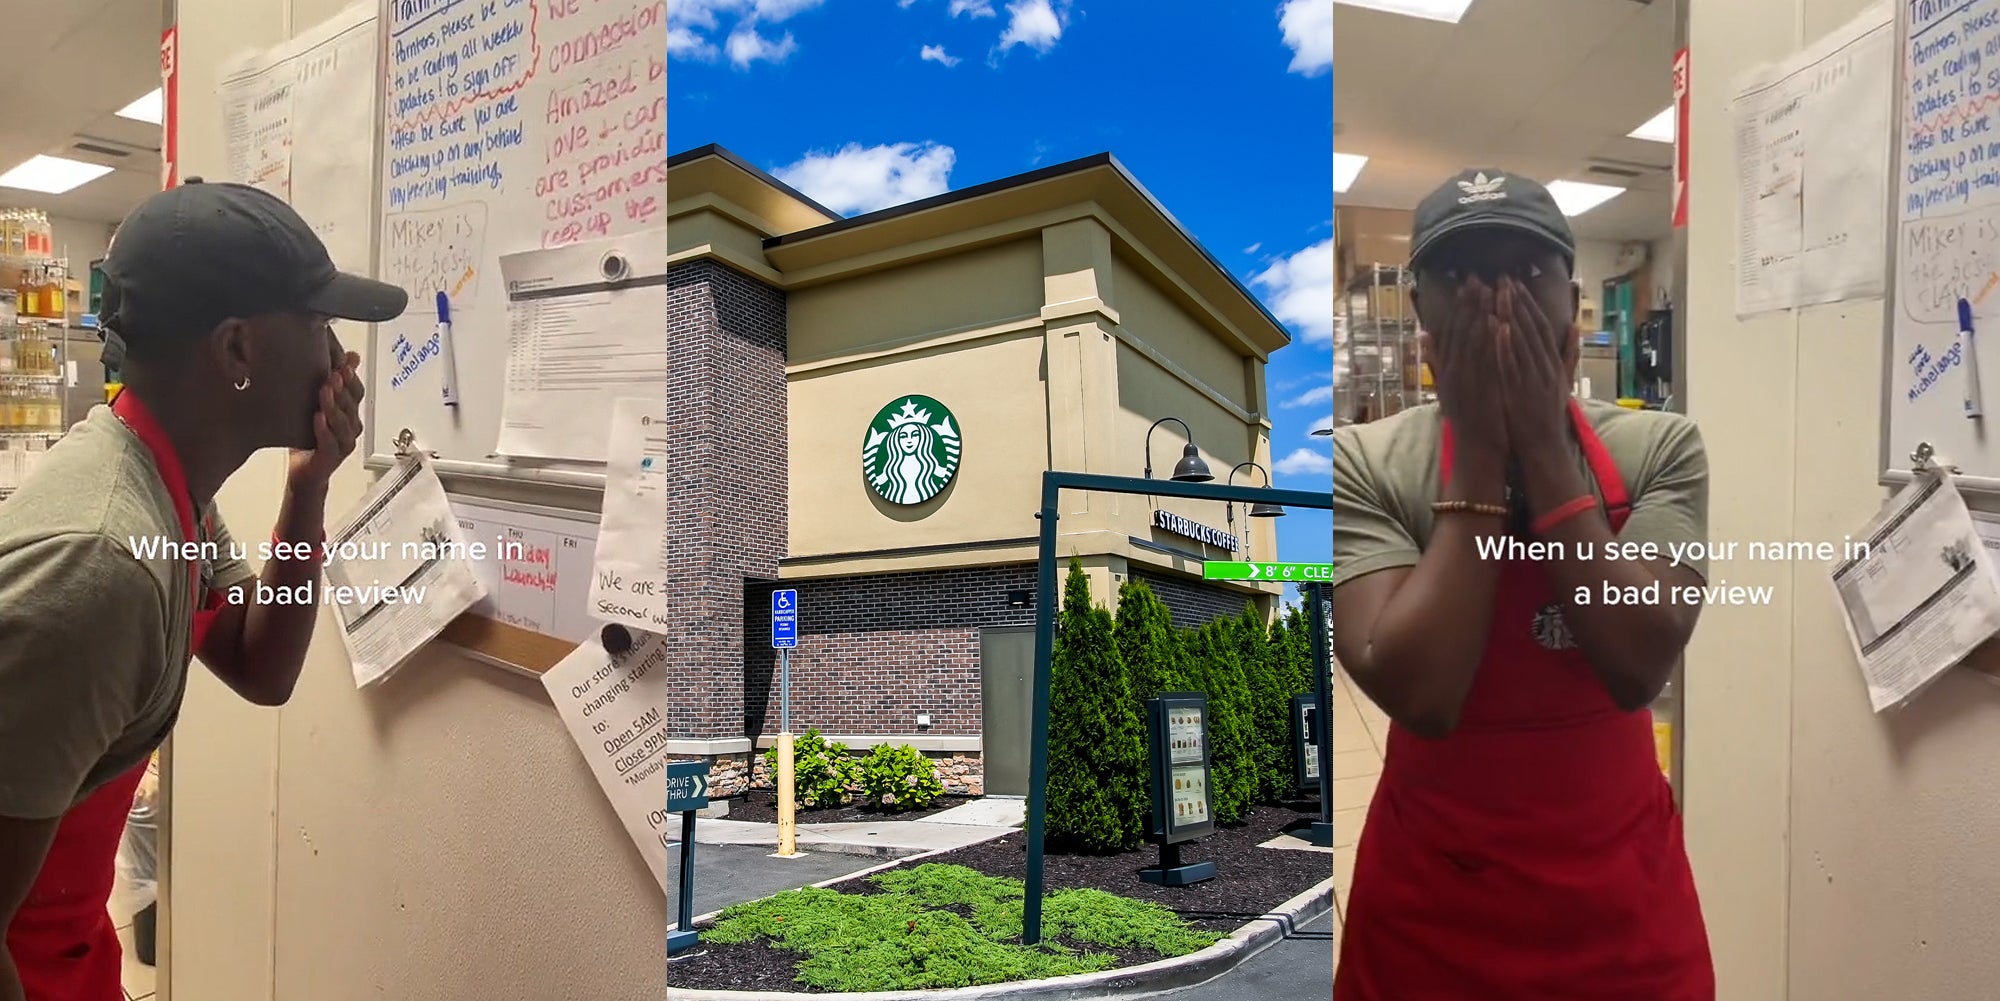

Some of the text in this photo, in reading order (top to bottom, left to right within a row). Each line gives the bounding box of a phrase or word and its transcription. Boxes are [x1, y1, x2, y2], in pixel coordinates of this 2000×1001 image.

[441, 14, 475, 42] please
[462, 39, 477, 59] all
[446, 78, 458, 97] to
[464, 69, 489, 97] sign
[546, 64, 636, 124] Amazed
[421, 123, 433, 141] be
[440, 116, 466, 137] sure
[495, 95, 518, 119] are
[432, 150, 444, 171] up
[486, 120, 522, 151] behind
[546, 126, 588, 163] love
[536, 170, 567, 197] are
[392, 214, 473, 248] Mikey is
[1910, 222, 1966, 257] Mikey
[508, 528, 523, 538] THU
[563, 538, 577, 549] FRI
[1159, 510, 1239, 552] STARBUCKS COFFEE
[599, 570, 622, 591] We
[631, 579, 655, 595] are
[1265, 565, 1277, 577] 8'
[572, 681, 592, 699] Our
[582, 647, 665, 717] changing starting
[592, 719, 610, 735] to:
[603, 707, 660, 755] Open 5AM
[615, 747, 646, 773] Close
[667, 777, 690, 788] DRIVE
